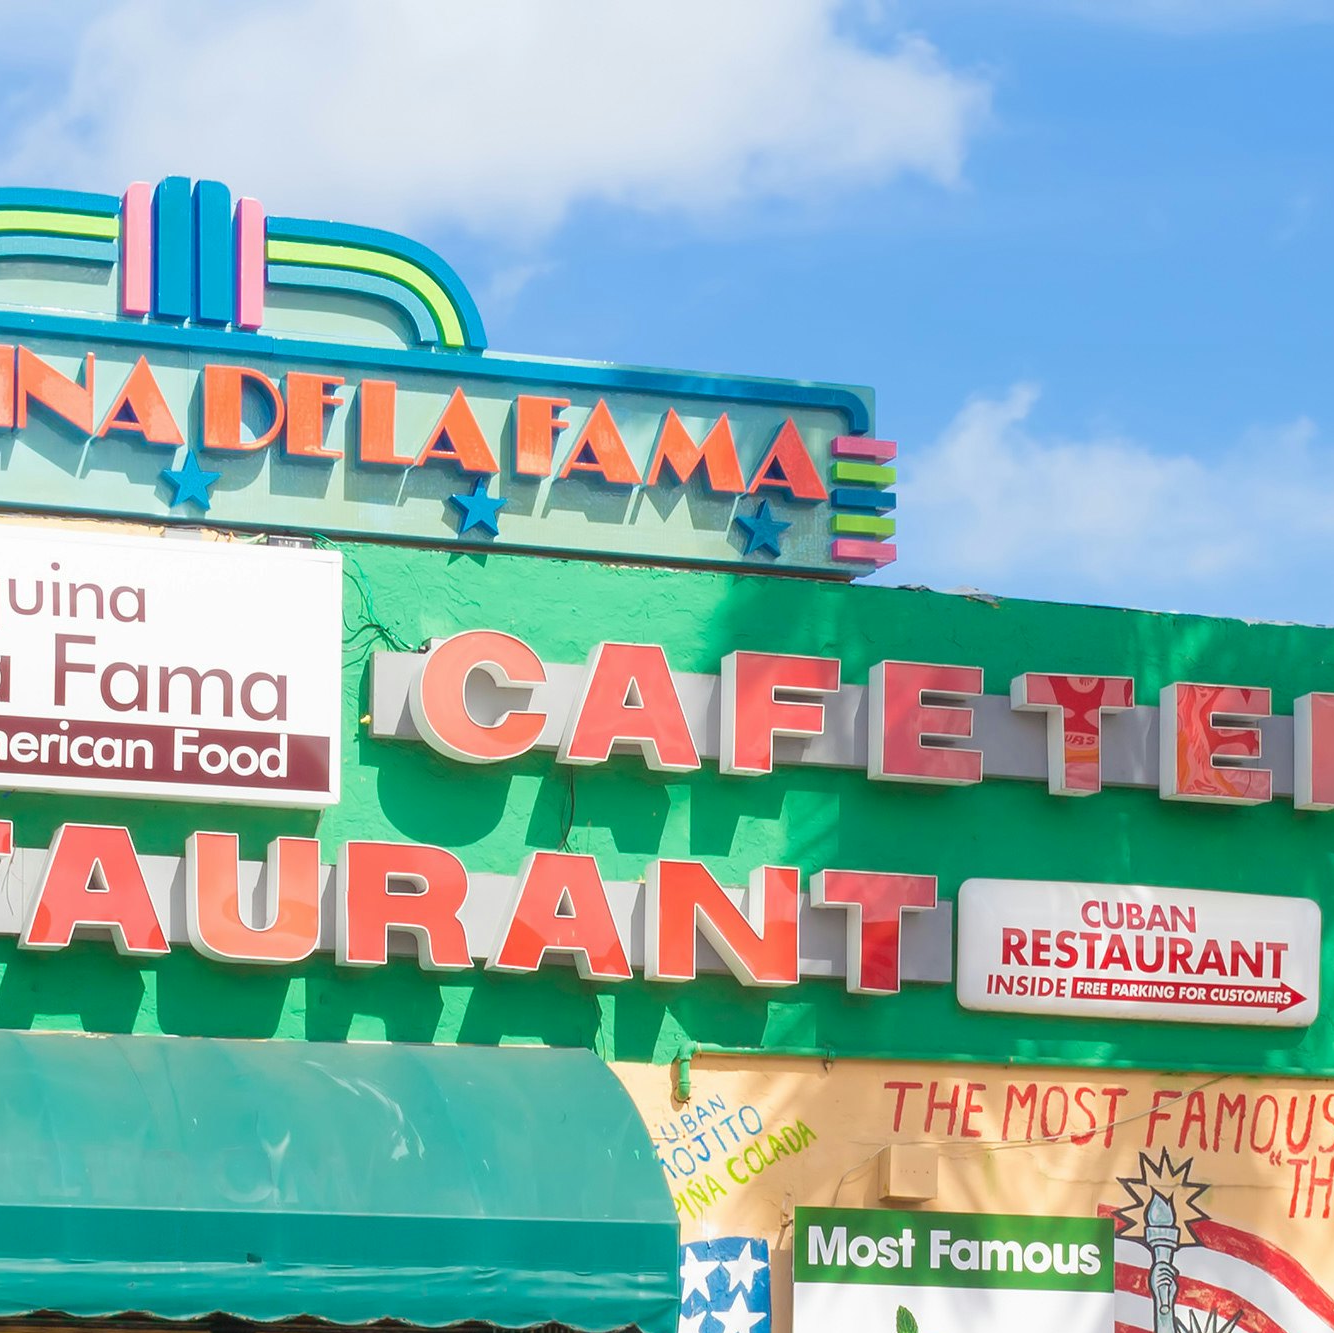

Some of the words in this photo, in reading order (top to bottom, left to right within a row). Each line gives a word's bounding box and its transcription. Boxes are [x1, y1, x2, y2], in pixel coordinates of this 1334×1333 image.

[203, 364, 345, 459] DE
[360, 380, 500, 474] LA
[517, 394, 829, 501] FAMA
[54, 633, 288, 721] Fama
[173, 730, 288, 778] Food
[1081, 900, 1197, 933] CUBAN
[1002, 927, 1289, 979] RESTAURANT
[986, 974, 1067, 998] INSIDE
[1076, 981, 1108, 996] FREE
[1111, 983, 1174, 999] PARKING
[1178, 987, 1207, 1000] FOR
[1210, 988, 1292, 1005] CUSTOMERS
[655, 1094, 726, 1149] UBAN
[884, 1081, 984, 1139] THE
[1001, 1082, 1127, 1148] MOST
[726, 1119, 817, 1184] COLADA
[807, 1225, 915, 1267] Most
[930, 1230, 1101, 1275] Famous
